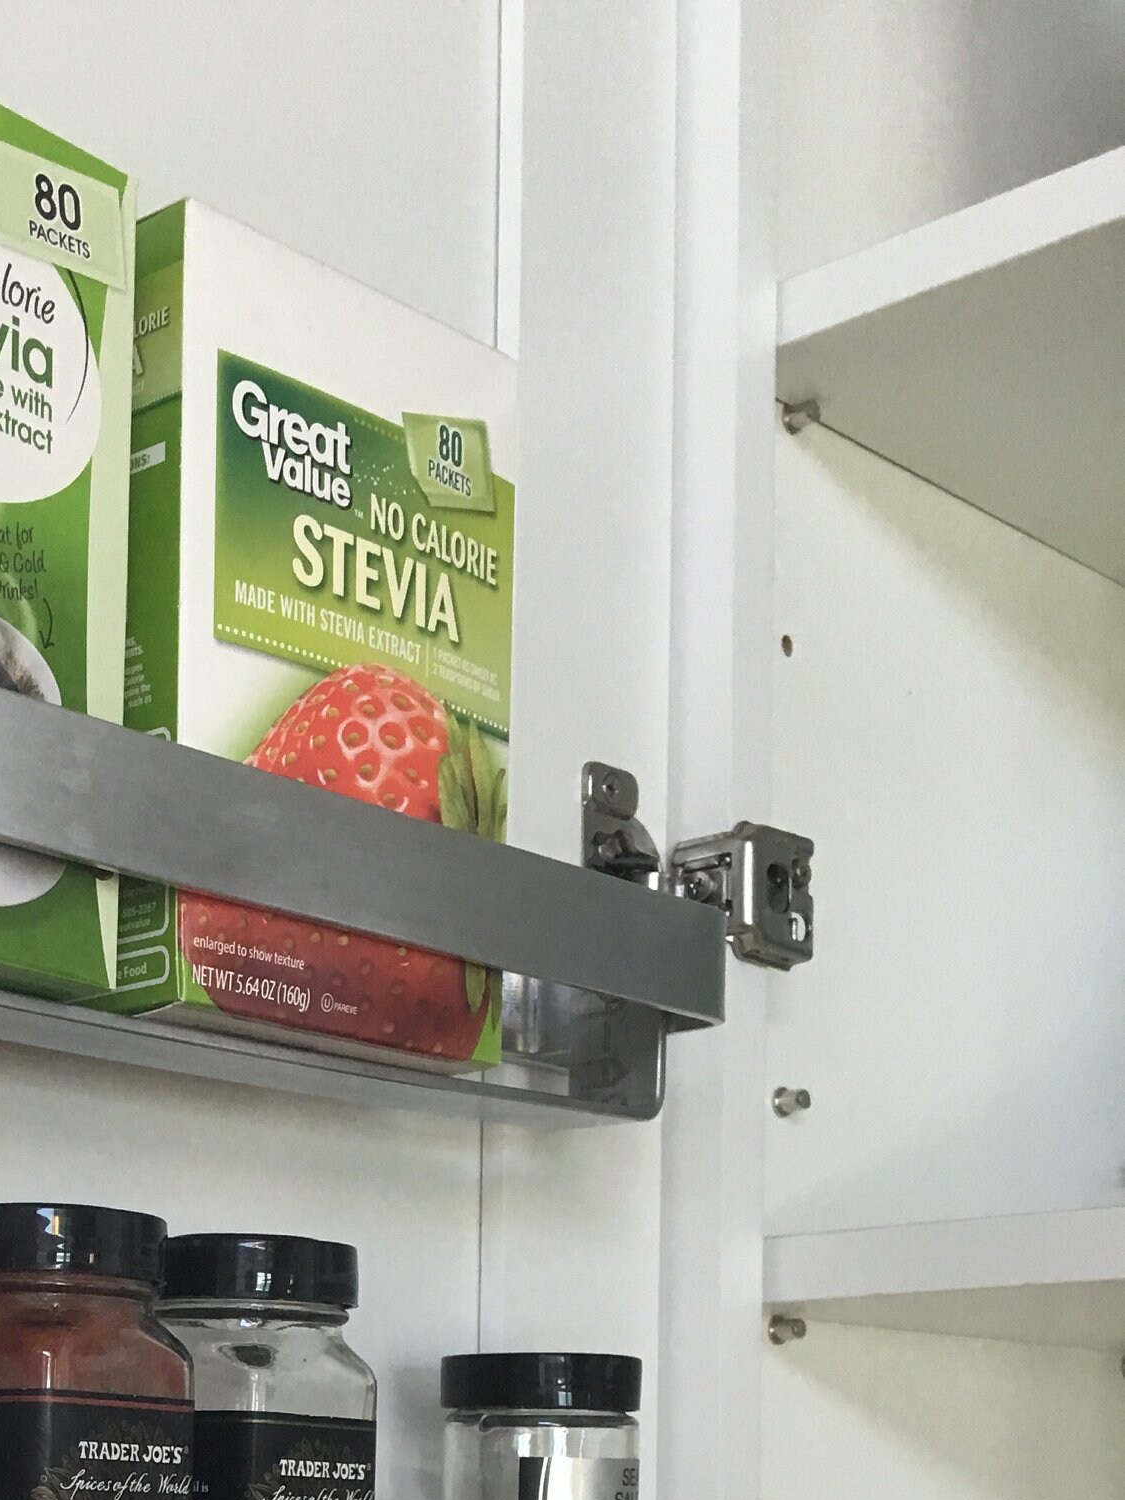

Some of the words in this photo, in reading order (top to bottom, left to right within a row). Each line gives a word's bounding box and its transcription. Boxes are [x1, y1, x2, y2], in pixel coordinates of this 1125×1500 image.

[34, 173, 82, 231] 80
[29, 220, 91, 259] PACKETS
[11, 384, 53, 423] with
[232, 380, 353, 475] Great
[438, 425, 462, 468] 80
[262, 440, 353, 508] Value
[428, 459, 472, 497] PACKETS
[16, 522, 33, 548] for
[371, 493, 404, 540] NO
[412, 513, 497, 585] CALORIE
[0, 551, 9, 572] &
[13, 549, 46, 573] Cold
[292, 515, 459, 643] STEVIA
[235, 580, 275, 614] MADE
[280, 594, 315, 627] WITH
[320, 611, 365, 645] STEVIA
[369, 627, 421, 665] EXTRACT
[124, 962, 147, 978] Food
[194, 936, 235, 956] enlarged
[237, 943, 247, 958] to
[249, 945, 273, 961] show
[275, 953, 305, 970] texture
[193, 964, 215, 987] NET
[216, 970, 234, 991] WT
[236, 975, 259, 996] 5.64
[261, 980, 276, 999] OZ
[277, 982, 311, 1012] (160g)
[334, 1001, 358, 1015] PAREVE
[78, 1440, 140, 1463] TRADER
[142, 1444, 183, 1465] JOE'S
[279, 1459, 330, 1479] TRADER
[332, 1461, 366, 1481] JOE'S
[60, 1469, 114, 1500] Spices
[128, 1473, 150, 1495] the
[158, 1470, 193, 1496] World
